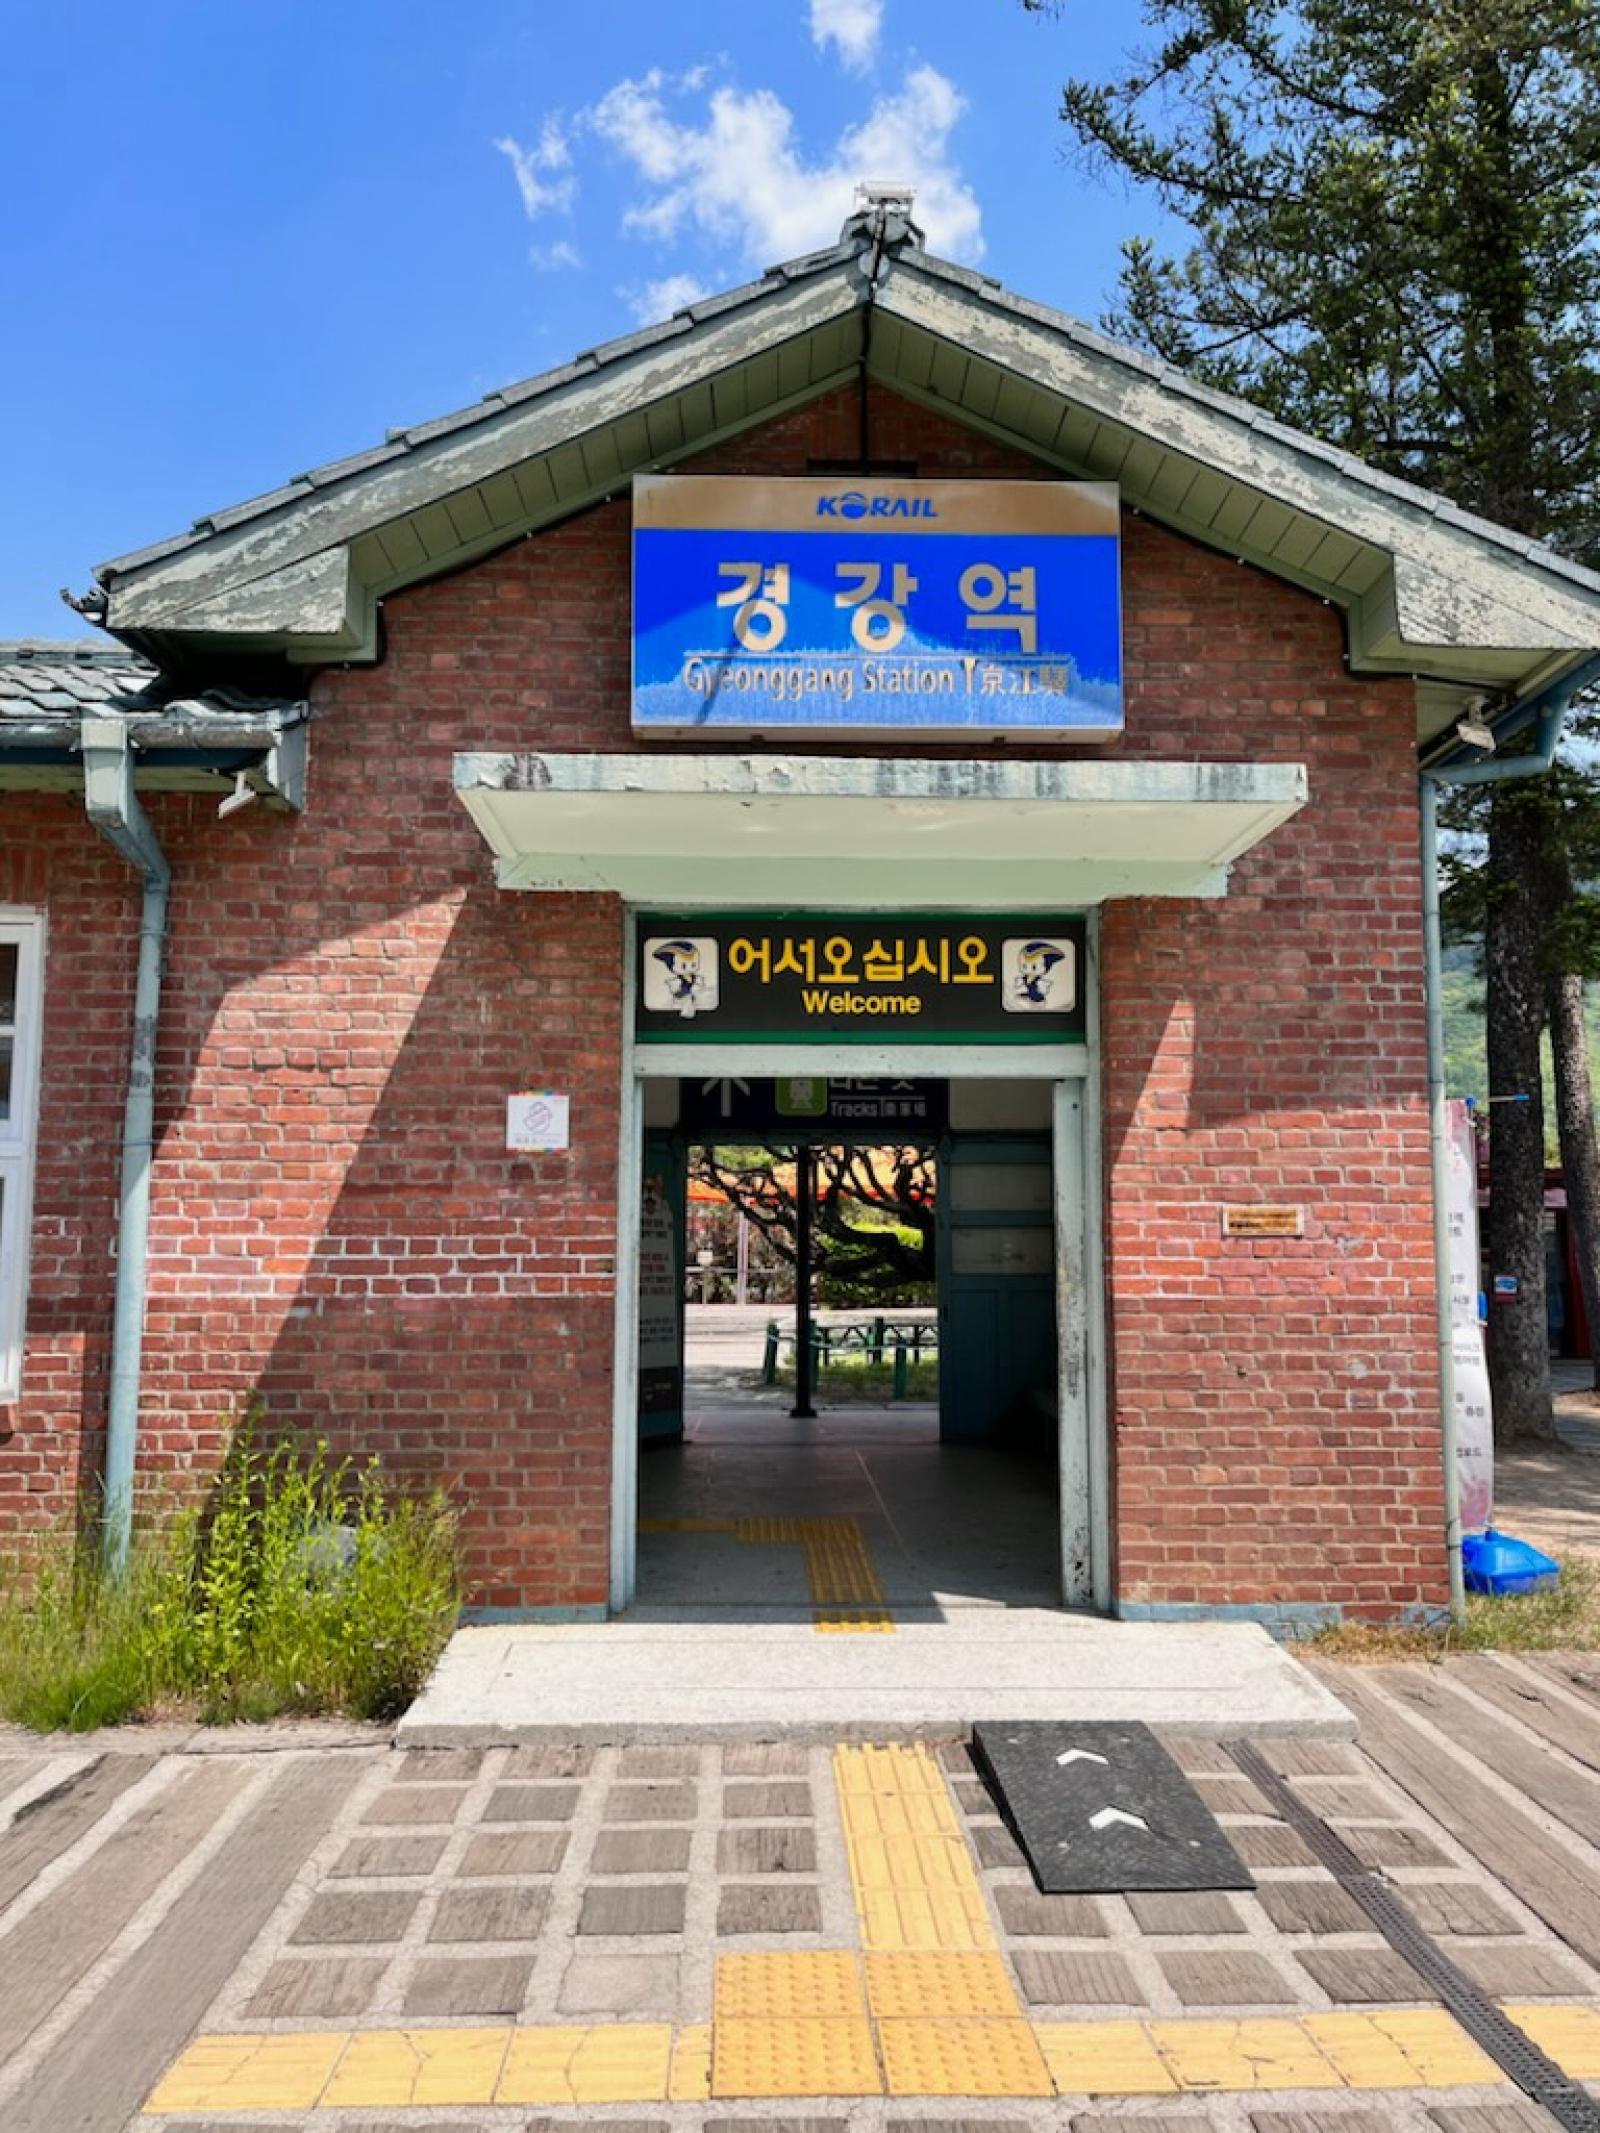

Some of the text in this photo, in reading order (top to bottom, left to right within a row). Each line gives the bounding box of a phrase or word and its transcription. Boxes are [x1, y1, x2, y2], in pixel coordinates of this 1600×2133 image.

[817, 492, 938, 519] KORAIL
[684, 658, 953, 701] Gyeonggang Station
[728, 936, 994, 983] 어서오십시오
[801, 990, 921, 1014] Welcome
[831, 1101, 878, 1117] Tracks
